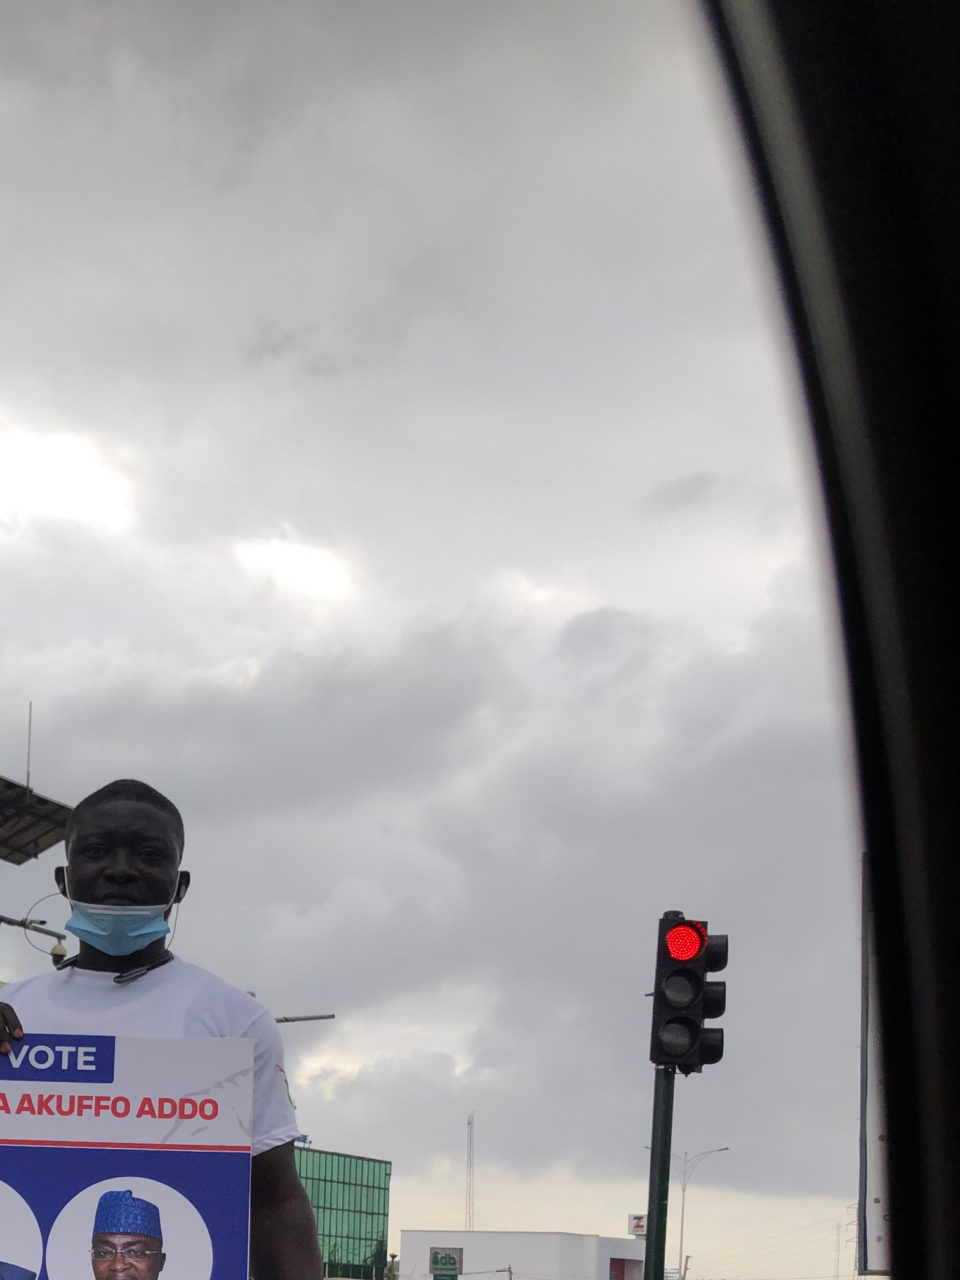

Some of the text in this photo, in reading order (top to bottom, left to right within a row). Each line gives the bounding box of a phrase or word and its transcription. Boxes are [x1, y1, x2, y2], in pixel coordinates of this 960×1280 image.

[8, 1045, 96, 1071] VOTE
[15, 1094, 131, 1118] AKUFFO
[135, 1098, 219, 1121] ADDO
